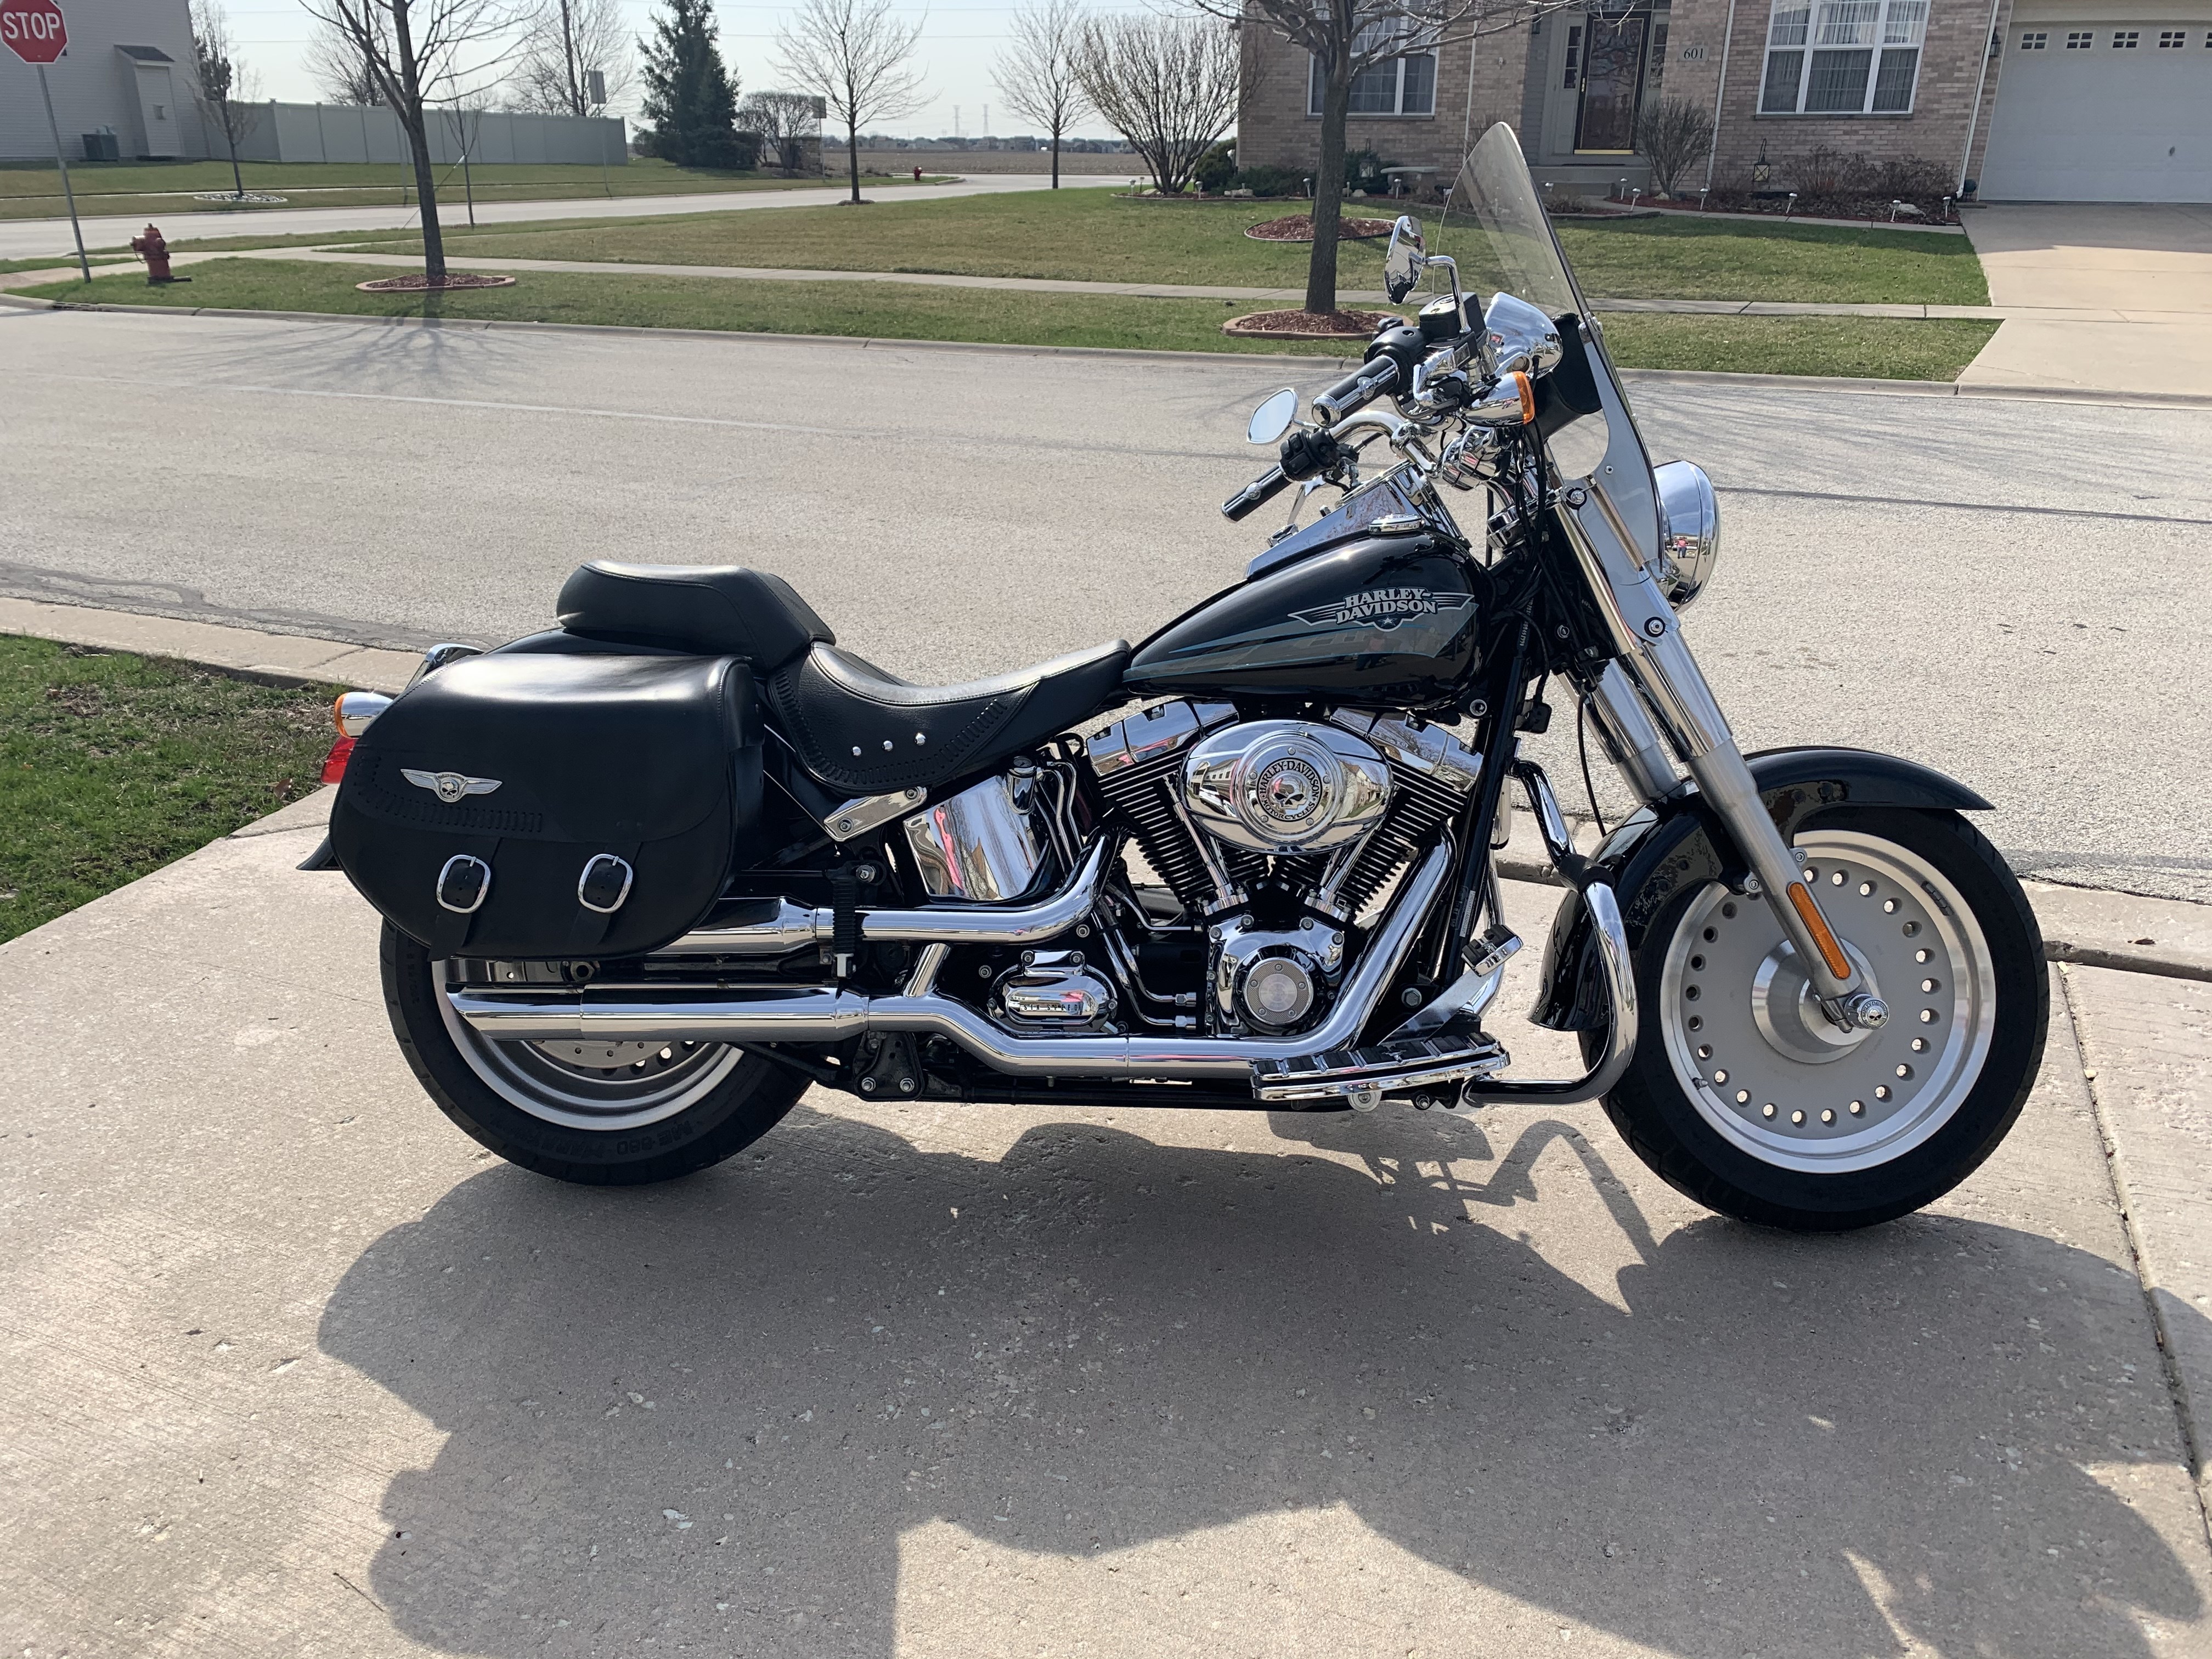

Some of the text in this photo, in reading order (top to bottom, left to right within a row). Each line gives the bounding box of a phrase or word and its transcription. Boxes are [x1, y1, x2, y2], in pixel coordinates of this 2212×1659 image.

[2, 12, 60, 40] STOP
[1684, 48, 1703, 59] 601
[1345, 588, 1431, 609] HARLEY-
[1336, 600, 1436, 624] DAVIDSON
[1262, 800, 1316, 820] MOTORCYCLES
